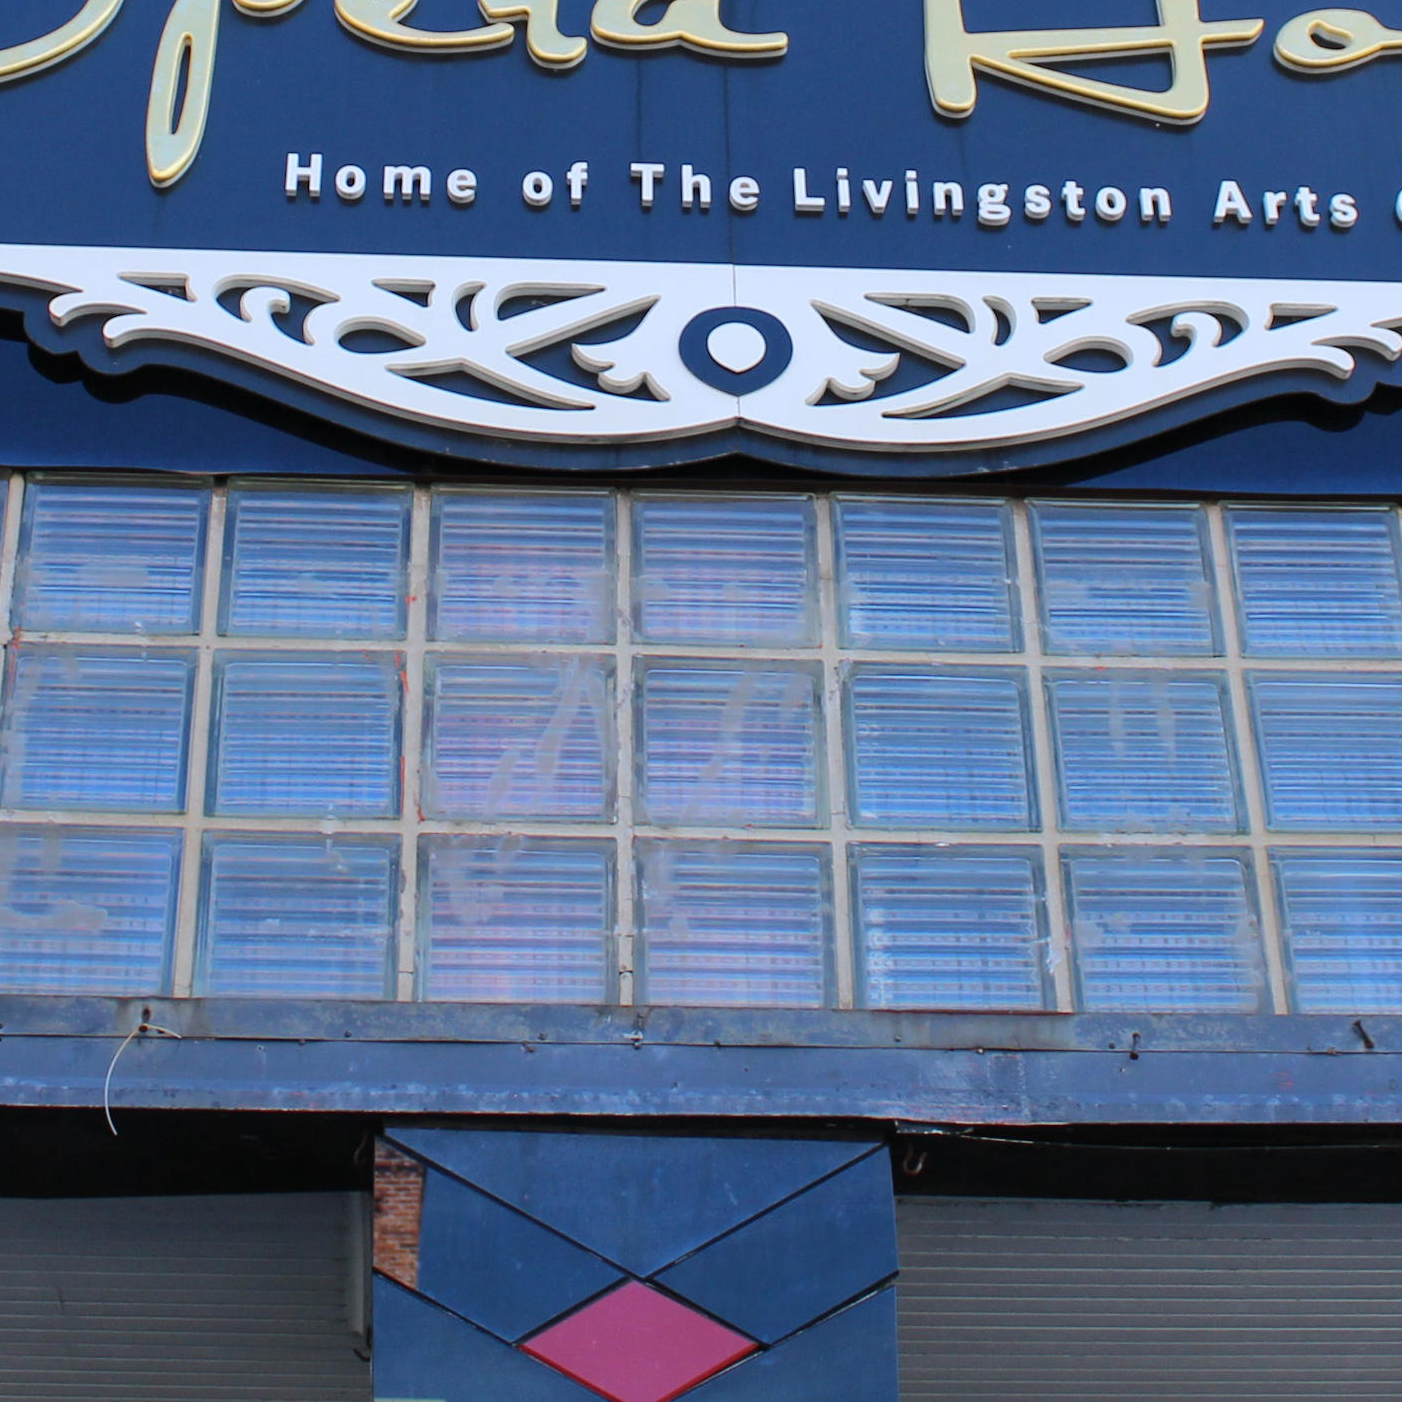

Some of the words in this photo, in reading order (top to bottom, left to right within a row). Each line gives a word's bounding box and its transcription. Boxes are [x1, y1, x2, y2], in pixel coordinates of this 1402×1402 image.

[284, 152, 478, 204] Home
[521, 160, 589, 206] of
[629, 161, 761, 209] The
[792, 165, 1173, 227] Livingston
[1213, 179, 1359, 230] Arts
